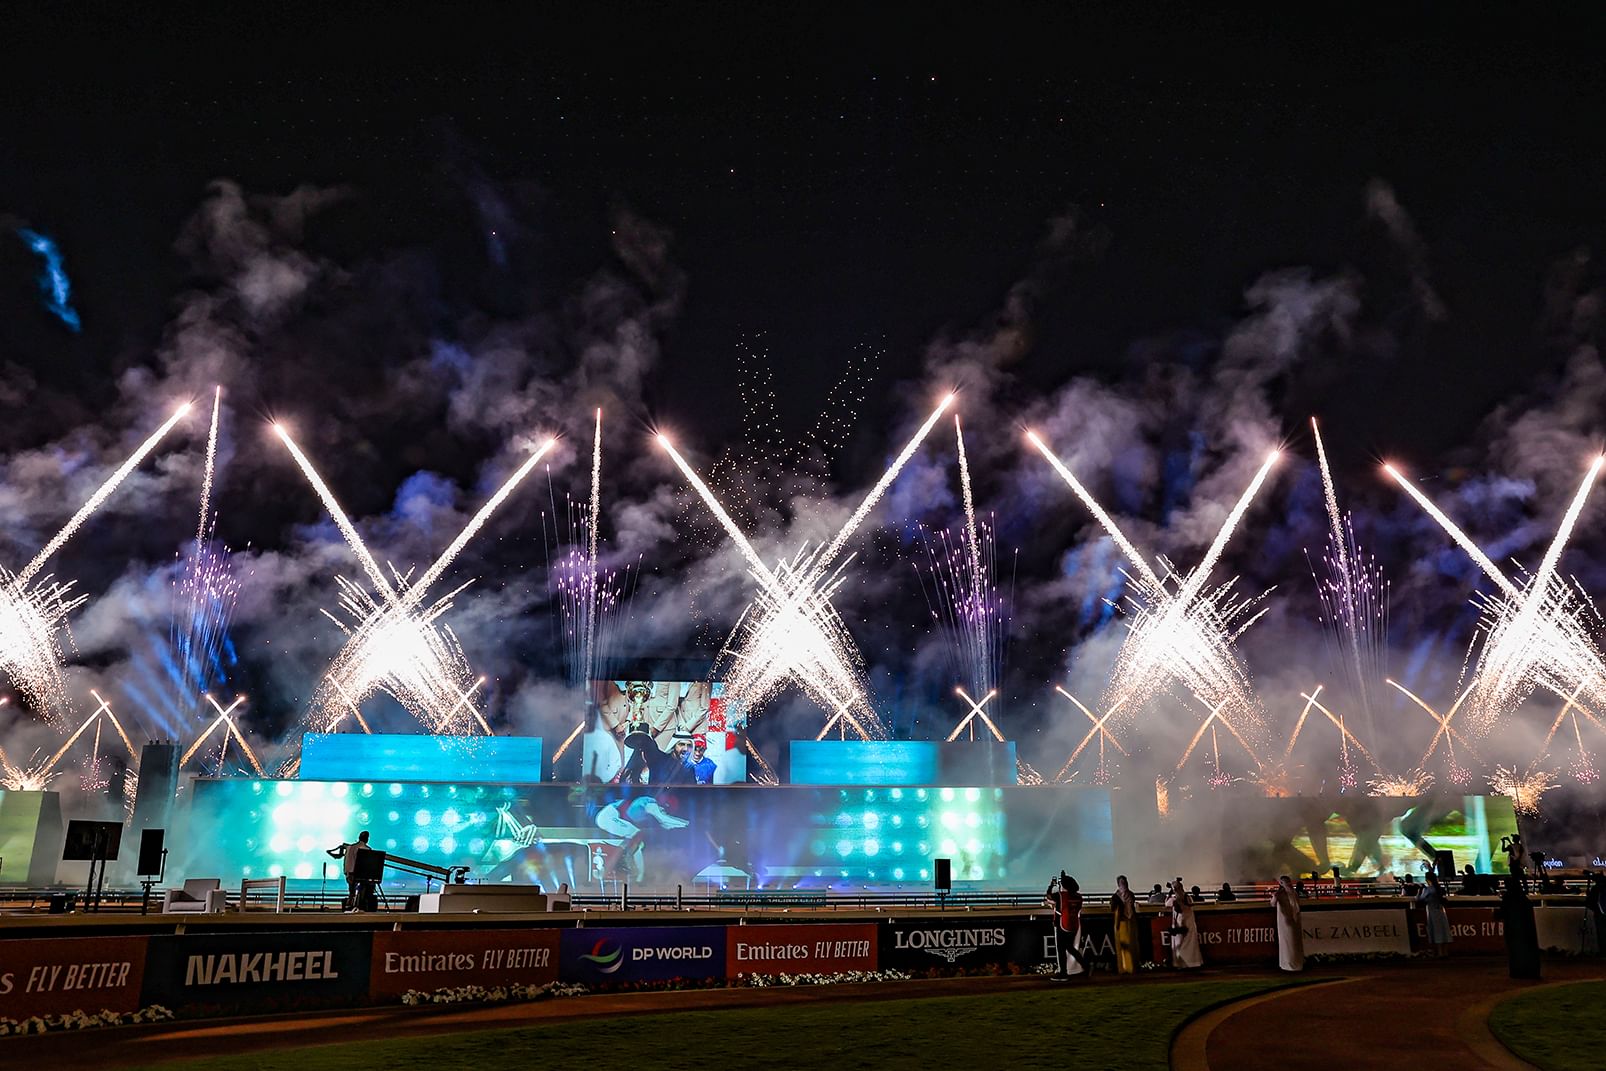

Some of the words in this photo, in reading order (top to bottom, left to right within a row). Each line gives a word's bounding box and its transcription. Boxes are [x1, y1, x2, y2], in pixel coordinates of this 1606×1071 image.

[894, 928, 1006, 949] LONGINES
[1227, 928, 1242, 944] FLY
[1244, 927, 1275, 943] BETTER
[1330, 924, 1401, 939] ZAABEEL
[1416, 923, 1476, 937] Eates
[1482, 922, 1495, 936] FLY
[384, 950, 475, 974] Emirates
[482, 948, 504, 970] FLY
[506, 948, 550, 969] BETTER
[632, 947, 654, 961] DP
[655, 946, 713, 961] WORLD
[736, 941, 809, 961] Emirates
[814, 941, 834, 959] FLY
[834, 940, 870, 959] BETTER
[25, 965, 63, 993] FLY
[63, 961, 131, 991] BETTER
[184, 951, 339, 986] NAKHEEL
